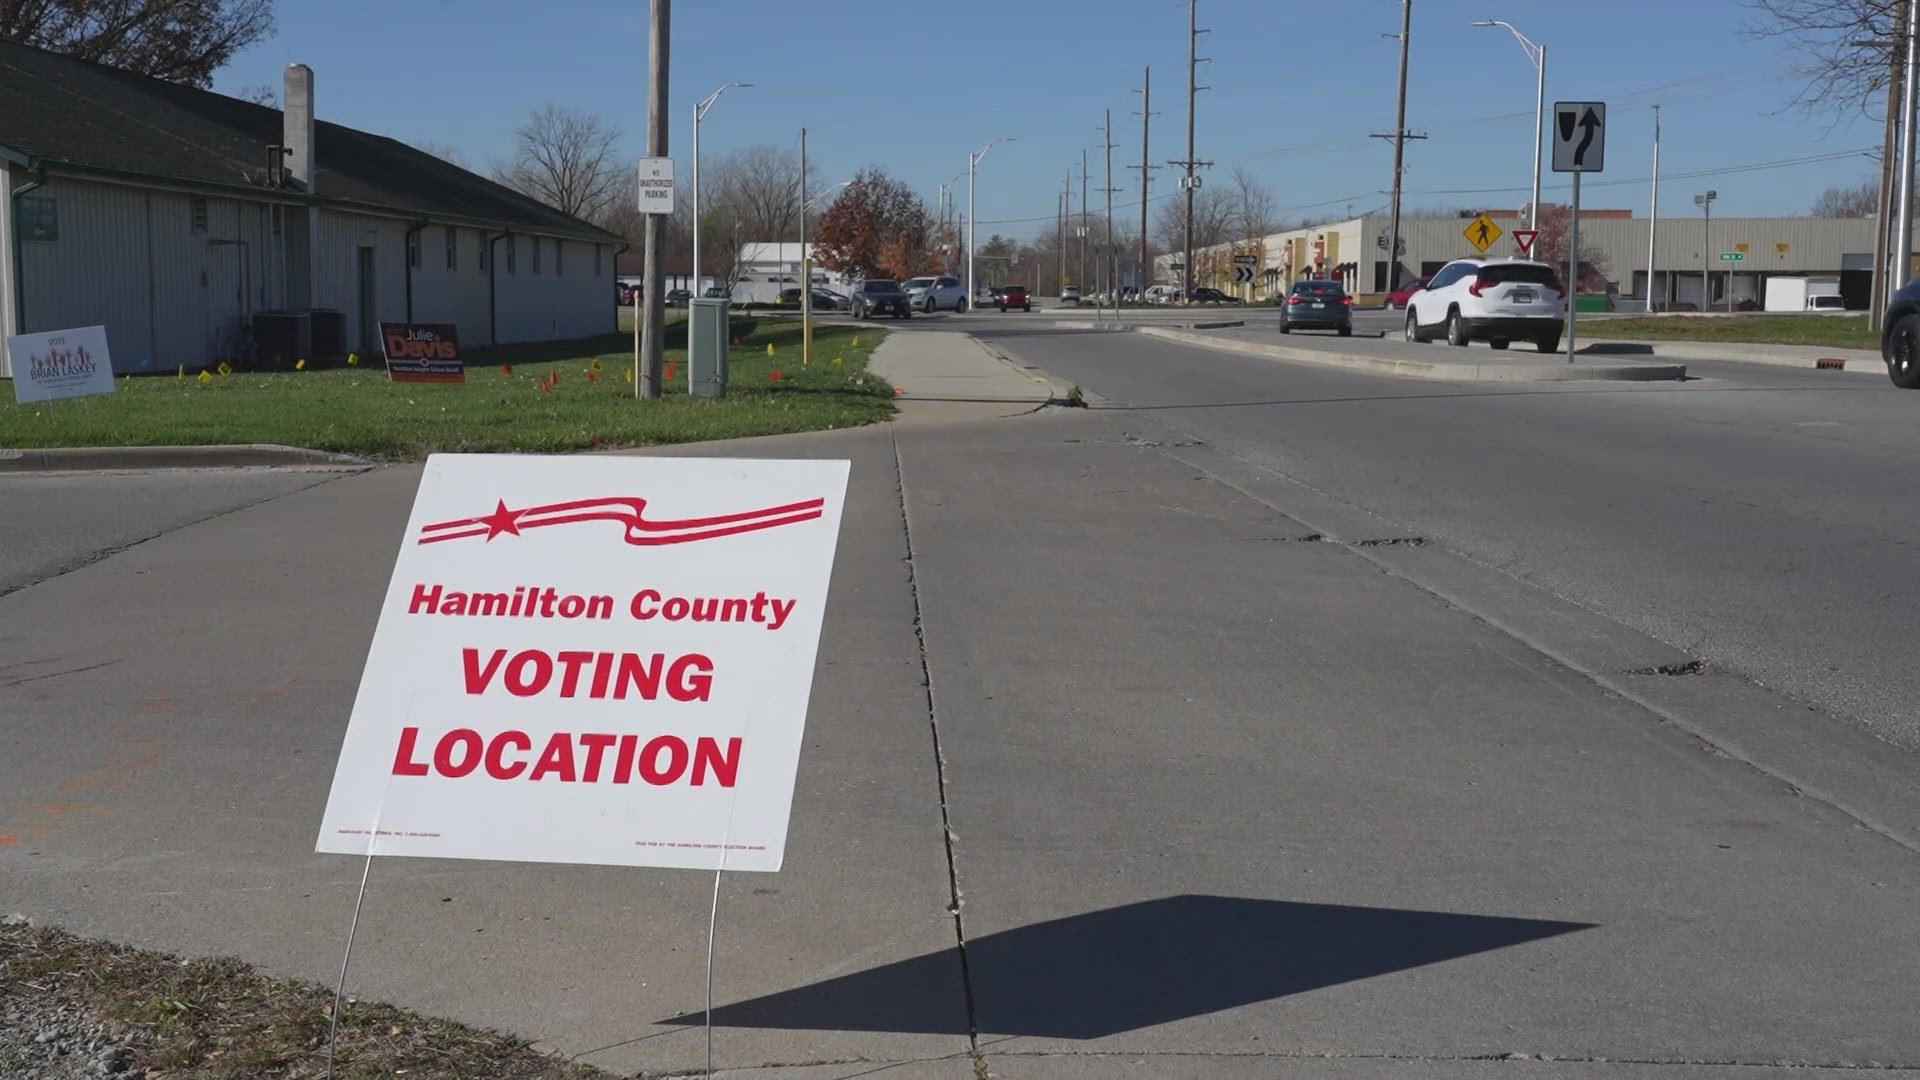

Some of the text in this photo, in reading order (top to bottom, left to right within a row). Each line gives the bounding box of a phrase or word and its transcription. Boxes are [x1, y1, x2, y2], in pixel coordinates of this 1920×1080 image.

[640, 179, 672, 187] UNAUTHORIZED
[645, 190, 668, 199] PARKING
[48, 336, 66, 346] VOTE
[406, 328, 433, 341] Julie
[387, 334, 457, 358] Davis
[30, 366, 60, 380] BRIAN
[62, 362, 97, 376] LASKEY
[409, 584, 796, 630] Hamilton County
[461, 648, 715, 702] VOTING
[392, 727, 743, 788] LOCATION
